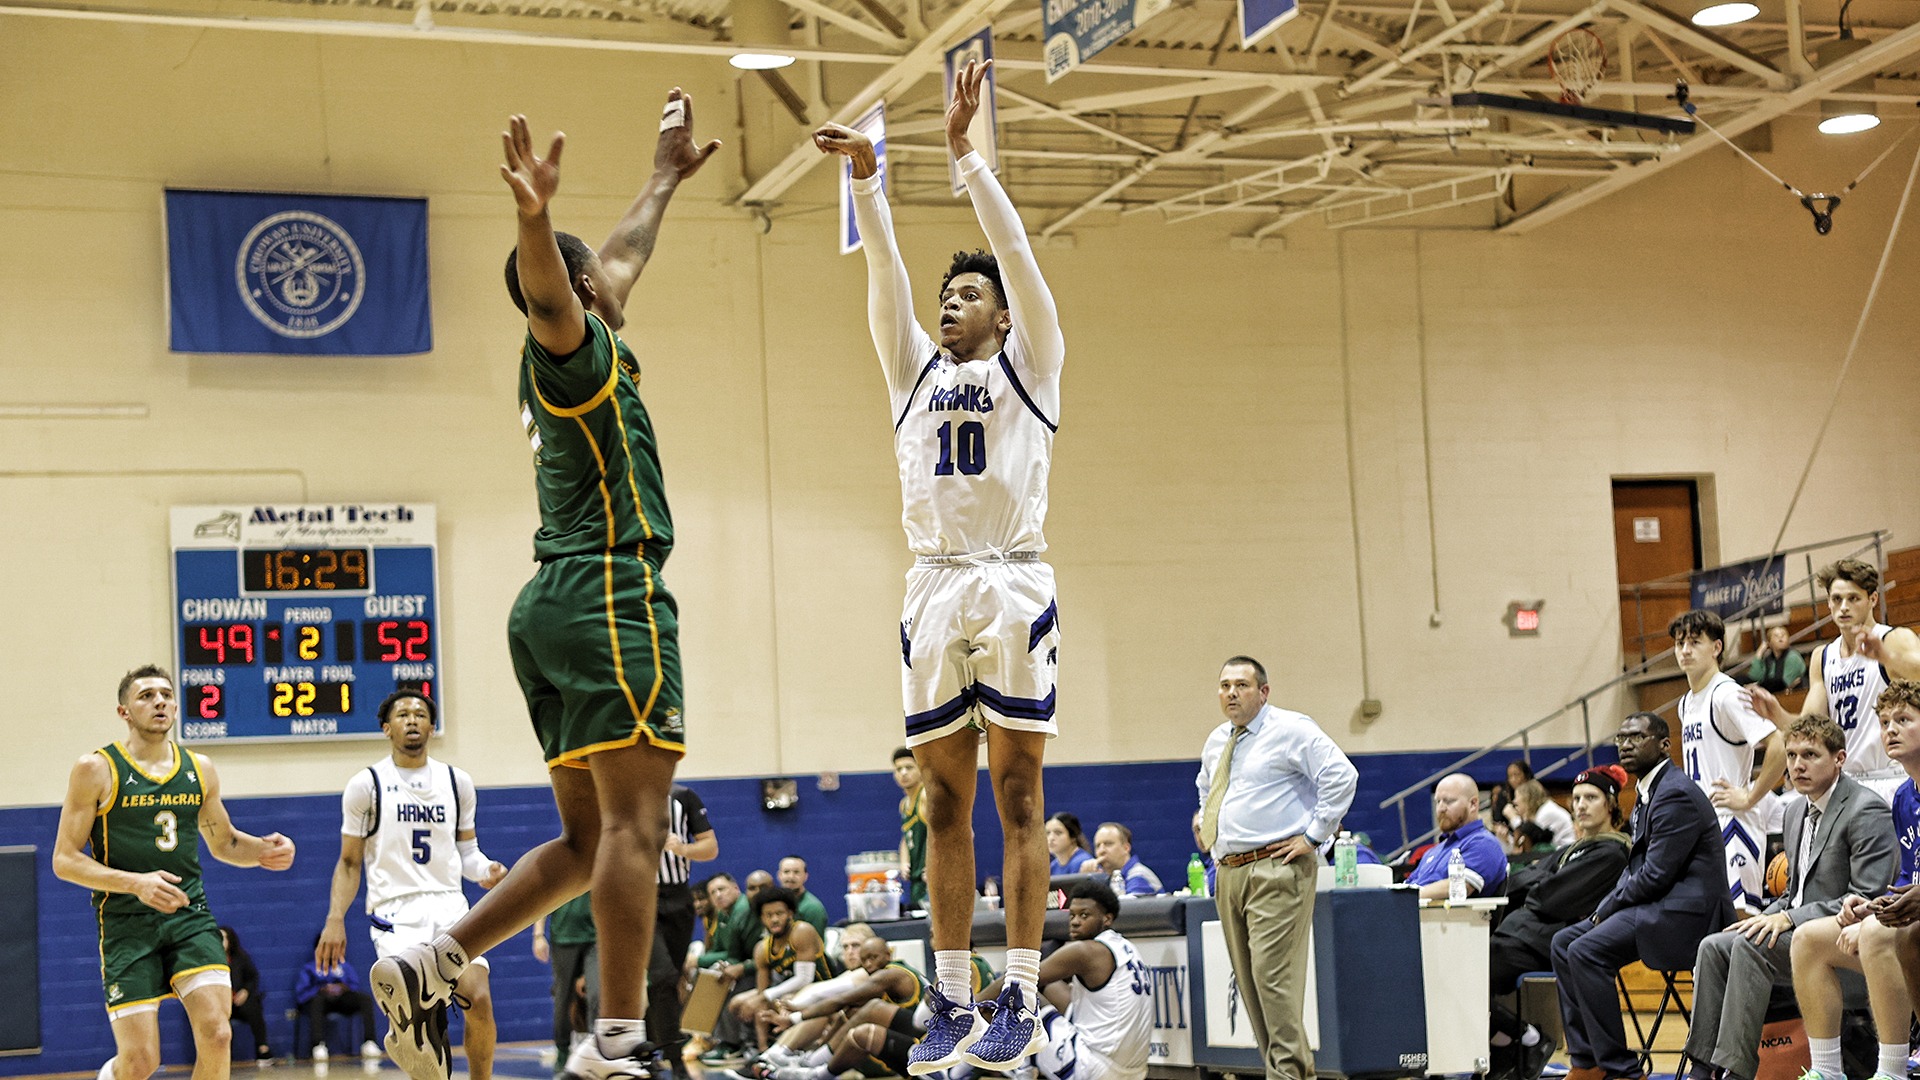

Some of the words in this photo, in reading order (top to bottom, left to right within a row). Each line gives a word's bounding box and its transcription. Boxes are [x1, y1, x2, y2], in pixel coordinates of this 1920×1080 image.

[928, 384, 994, 413] HAWKS
[934, 421, 987, 476] 10
[249, 506, 334, 525] Metal
[340, 506, 414, 522] Tech
[264, 550, 366, 590] 16:29
[364, 595, 428, 618] GUEST
[1703, 586, 1730, 608] MAKE
[1731, 584, 1742, 602] IT
[182, 598, 268, 621] CHOWAN
[284, 607, 333, 623] PERIOD
[200, 624, 254, 664] 49
[299, 626, 320, 661] 2
[377, 621, 430, 662] 52
[182, 668, 226, 685] FOULS
[263, 666, 315, 683] PLAYER
[321, 665, 357, 682] FOUL
[392, 663, 435, 679] FOULS
[1830, 667, 1865, 694] HAWKS
[200, 685, 221, 719] 2
[273, 682, 317, 717] 22
[1835, 694, 1858, 731] 12
[184, 723, 228, 738] SCORE
[290, 719, 338, 734] MATCH
[121, 793, 202, 808] LEES-McRAE
[397, 803, 446, 823] HAWKS
[153, 810, 179, 852] 3
[412, 829, 432, 865] 5
[1151, 965, 1187, 1029] ITY
[1761, 1036, 1793, 1049] NCAA
[1399, 1053, 1428, 1065] FISHER
